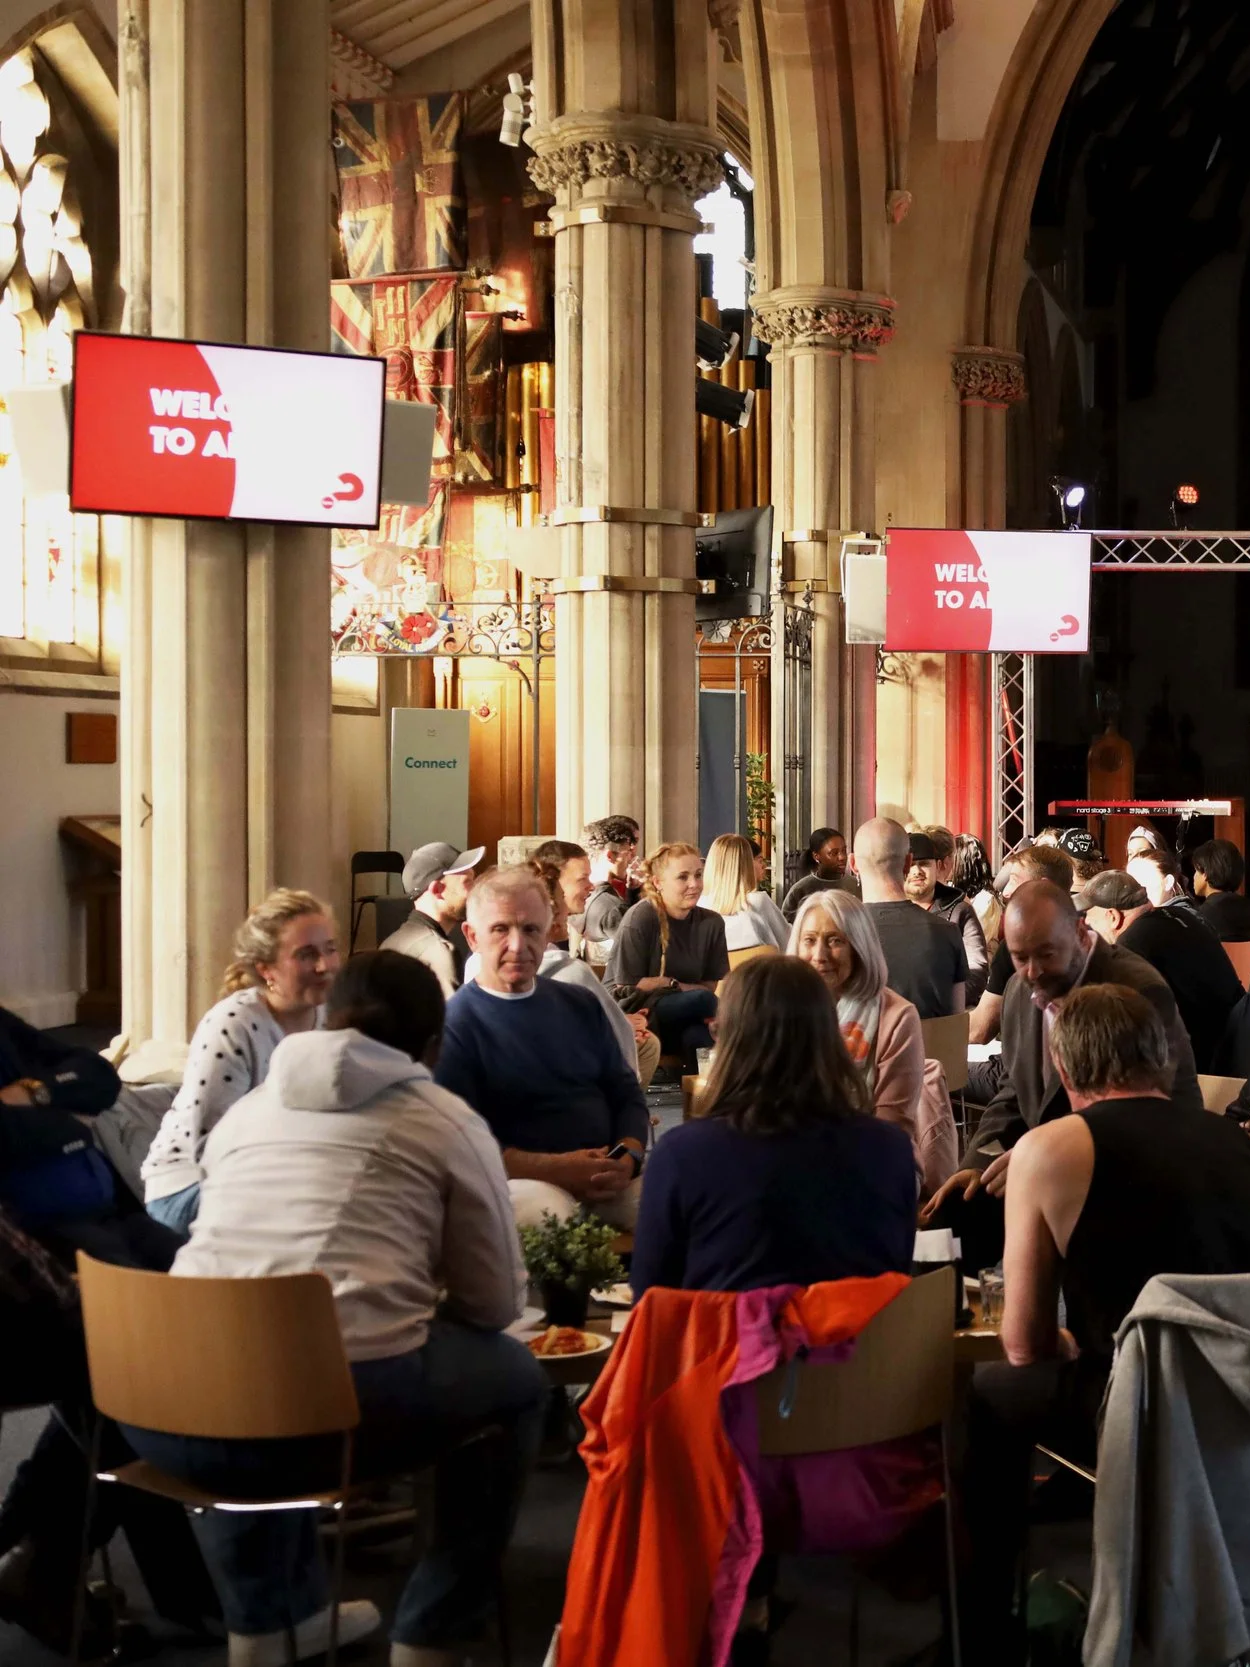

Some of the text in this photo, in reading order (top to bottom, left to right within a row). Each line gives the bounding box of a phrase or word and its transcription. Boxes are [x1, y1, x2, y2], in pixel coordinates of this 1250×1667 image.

[149, 426, 195, 456] TO
[934, 590, 964, 609] TO
[404, 756, 458, 769] Connect
[1091, 807, 1107, 815] stage
